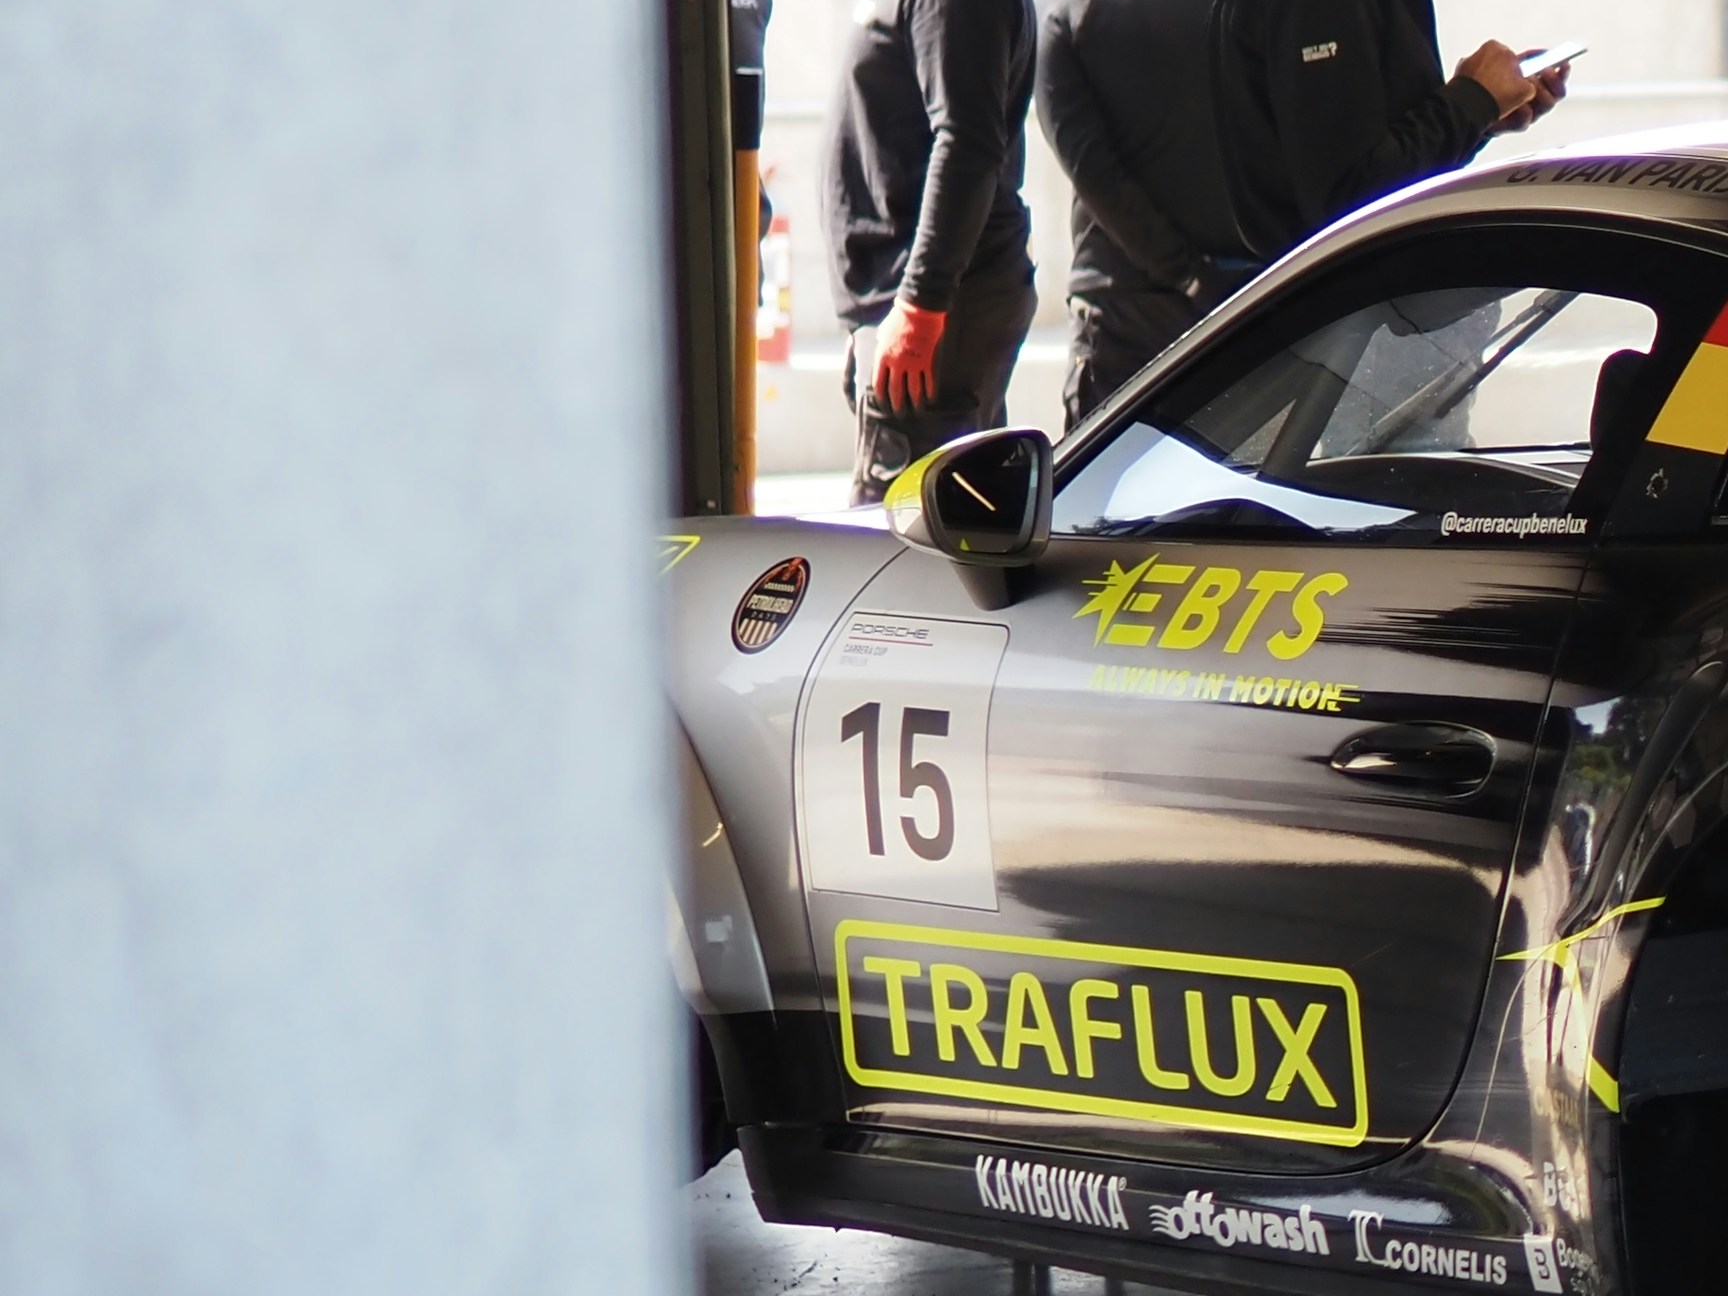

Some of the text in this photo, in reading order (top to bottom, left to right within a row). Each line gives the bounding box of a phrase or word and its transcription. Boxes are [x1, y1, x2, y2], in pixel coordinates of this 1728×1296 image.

[1551, 155, 1641, 184] VAN
[1441, 511, 1588, 539] @carreracupbenelux
[1090, 554, 1349, 660] EBTS
[850, 622, 930, 640] PORSCHE
[1086, 664, 1344, 712] ALWAYS IN MOTION
[841, 701, 954, 862] 15
[864, 956, 1337, 1108] TRAFLUX
[1385, 1239, 1507, 1285] CORNELIS
